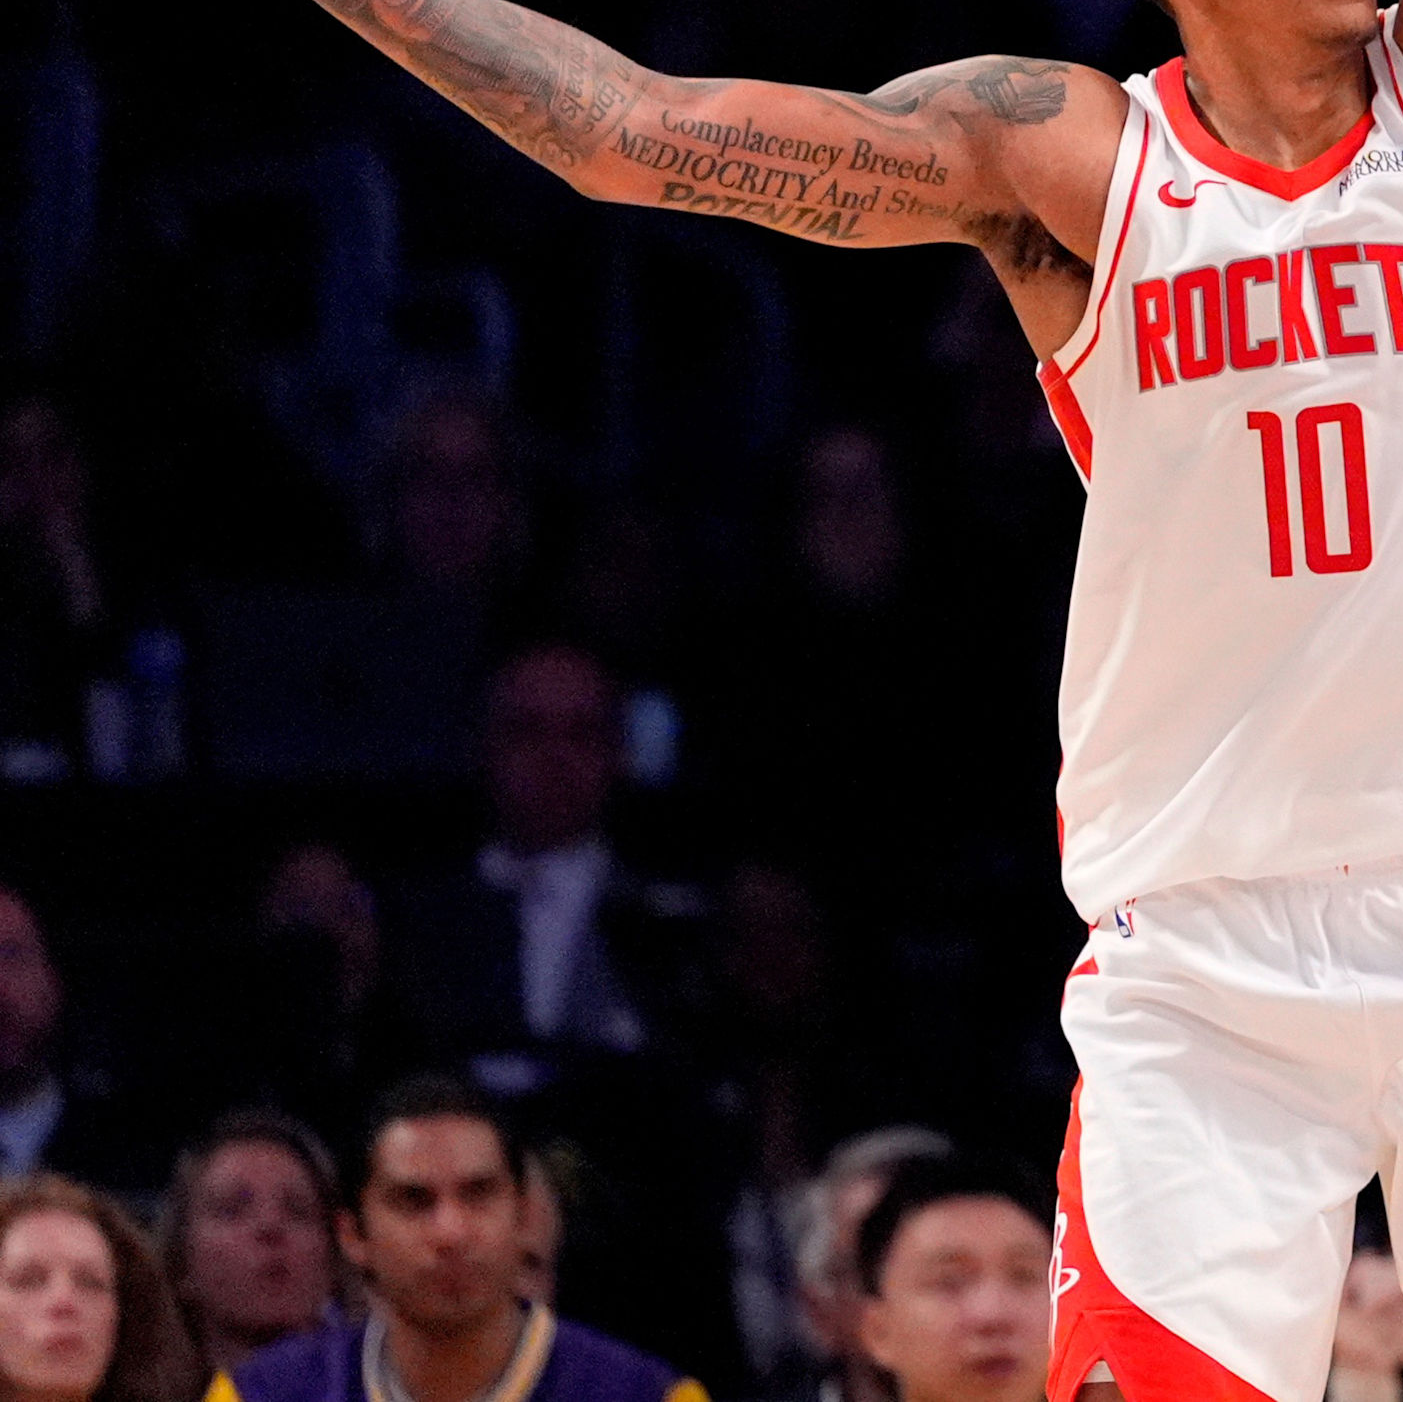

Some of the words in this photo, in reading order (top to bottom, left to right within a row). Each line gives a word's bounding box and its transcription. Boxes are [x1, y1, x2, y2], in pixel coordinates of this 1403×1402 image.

[610, 126, 822, 202] MEDIOCRITY
[817, 178, 882, 213] And
[660, 109, 843, 175] Complacency
[847, 138, 948, 186] Breeds
[1246, 402, 1373, 578] 10
